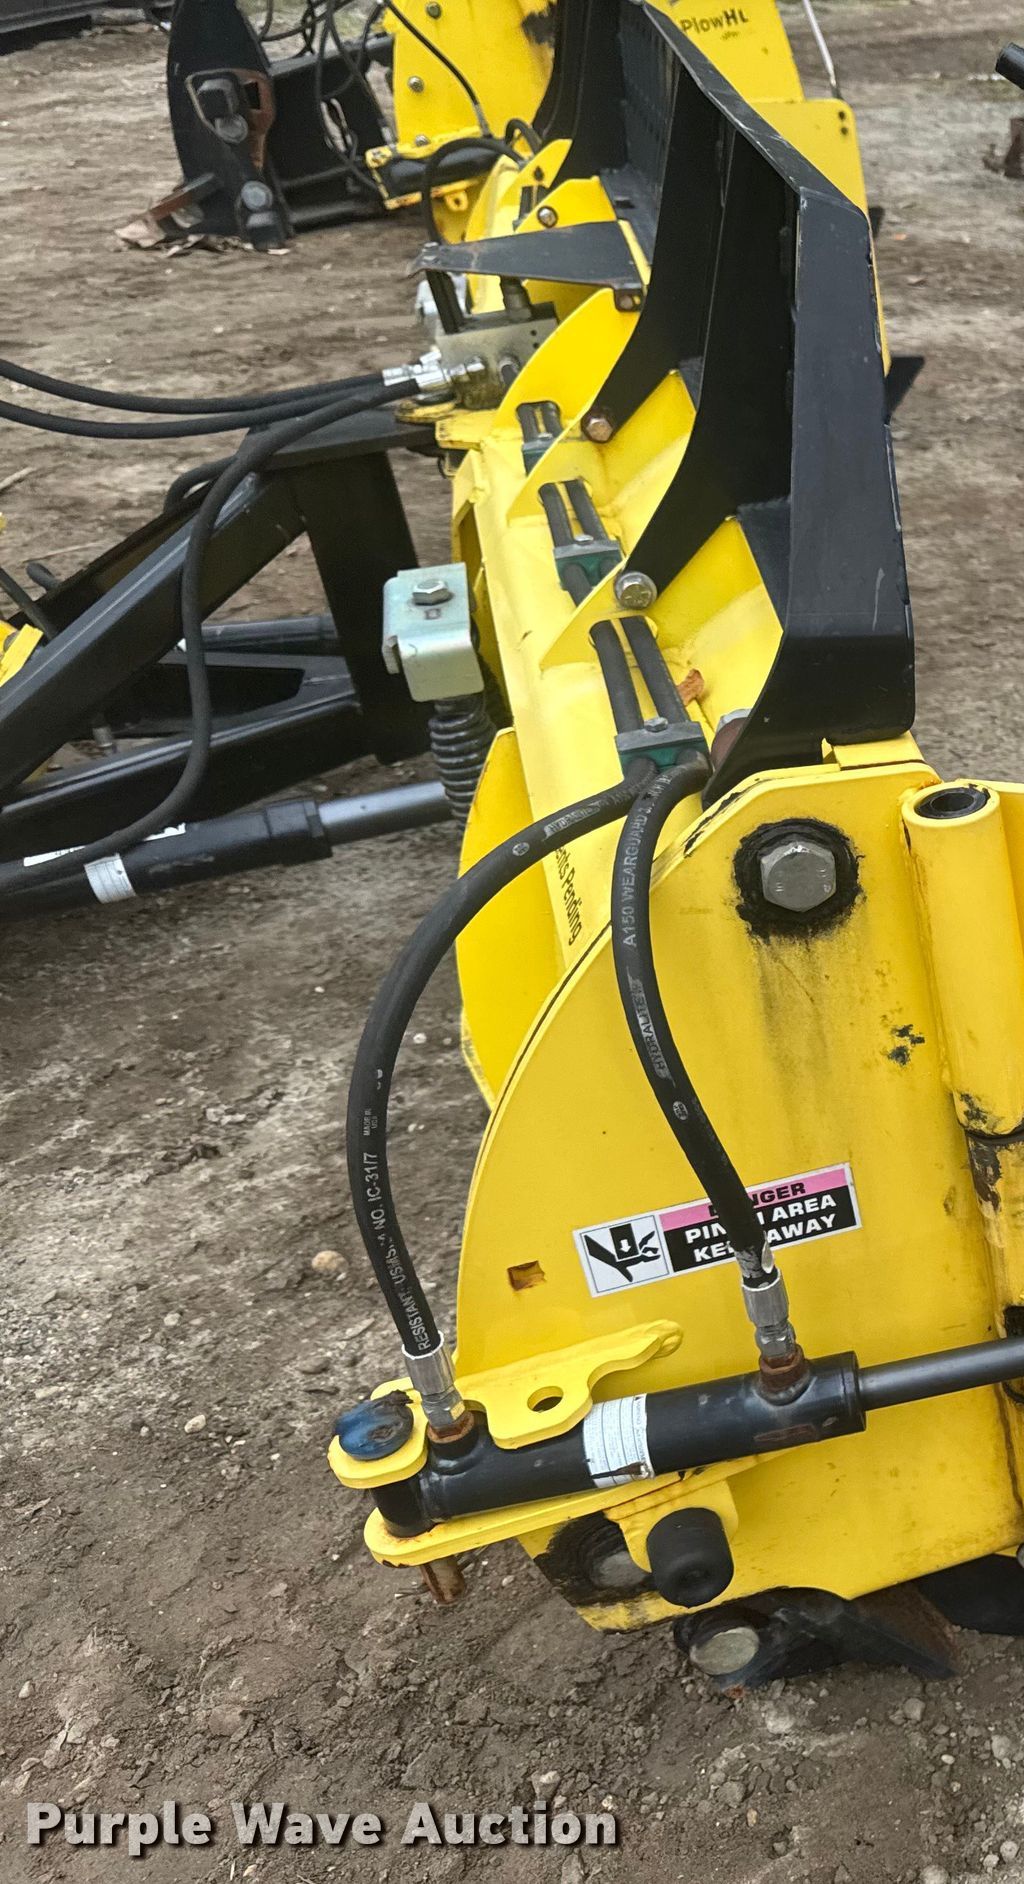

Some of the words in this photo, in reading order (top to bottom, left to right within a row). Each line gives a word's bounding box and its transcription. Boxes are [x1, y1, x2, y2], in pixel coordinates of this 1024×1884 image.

[562, 867, 583, 946] Pending
[621, 905, 637, 948] A150
[363, 1152, 382, 1202] IC-31/7
[765, 1194, 837, 1223] AREA
[766, 1213, 837, 1243] AWAY
